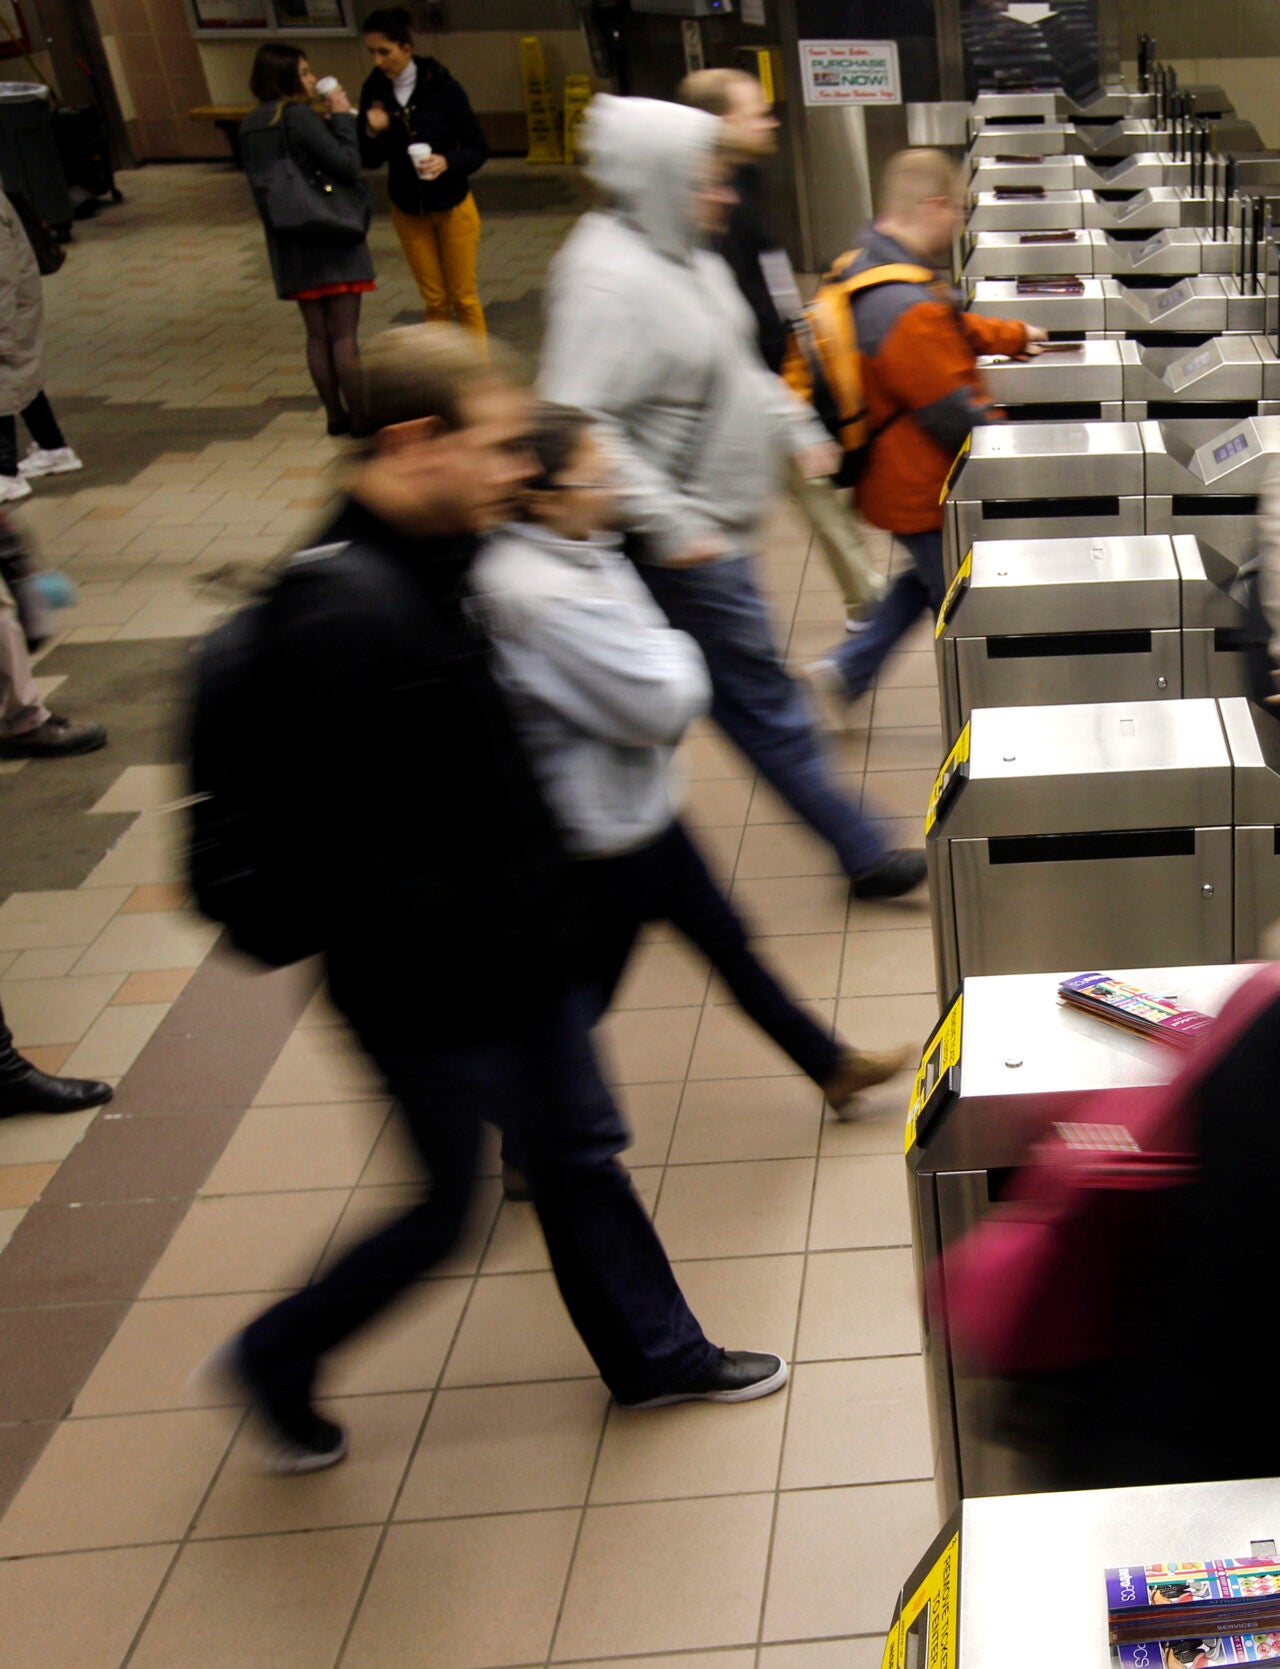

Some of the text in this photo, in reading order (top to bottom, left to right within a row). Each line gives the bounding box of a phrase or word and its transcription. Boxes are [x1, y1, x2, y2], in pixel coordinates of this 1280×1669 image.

[811, 59, 887, 69] PURCHASE
[841, 75, 888, 86] NOW!
[1216, 1621, 1259, 1631] SERVICES
